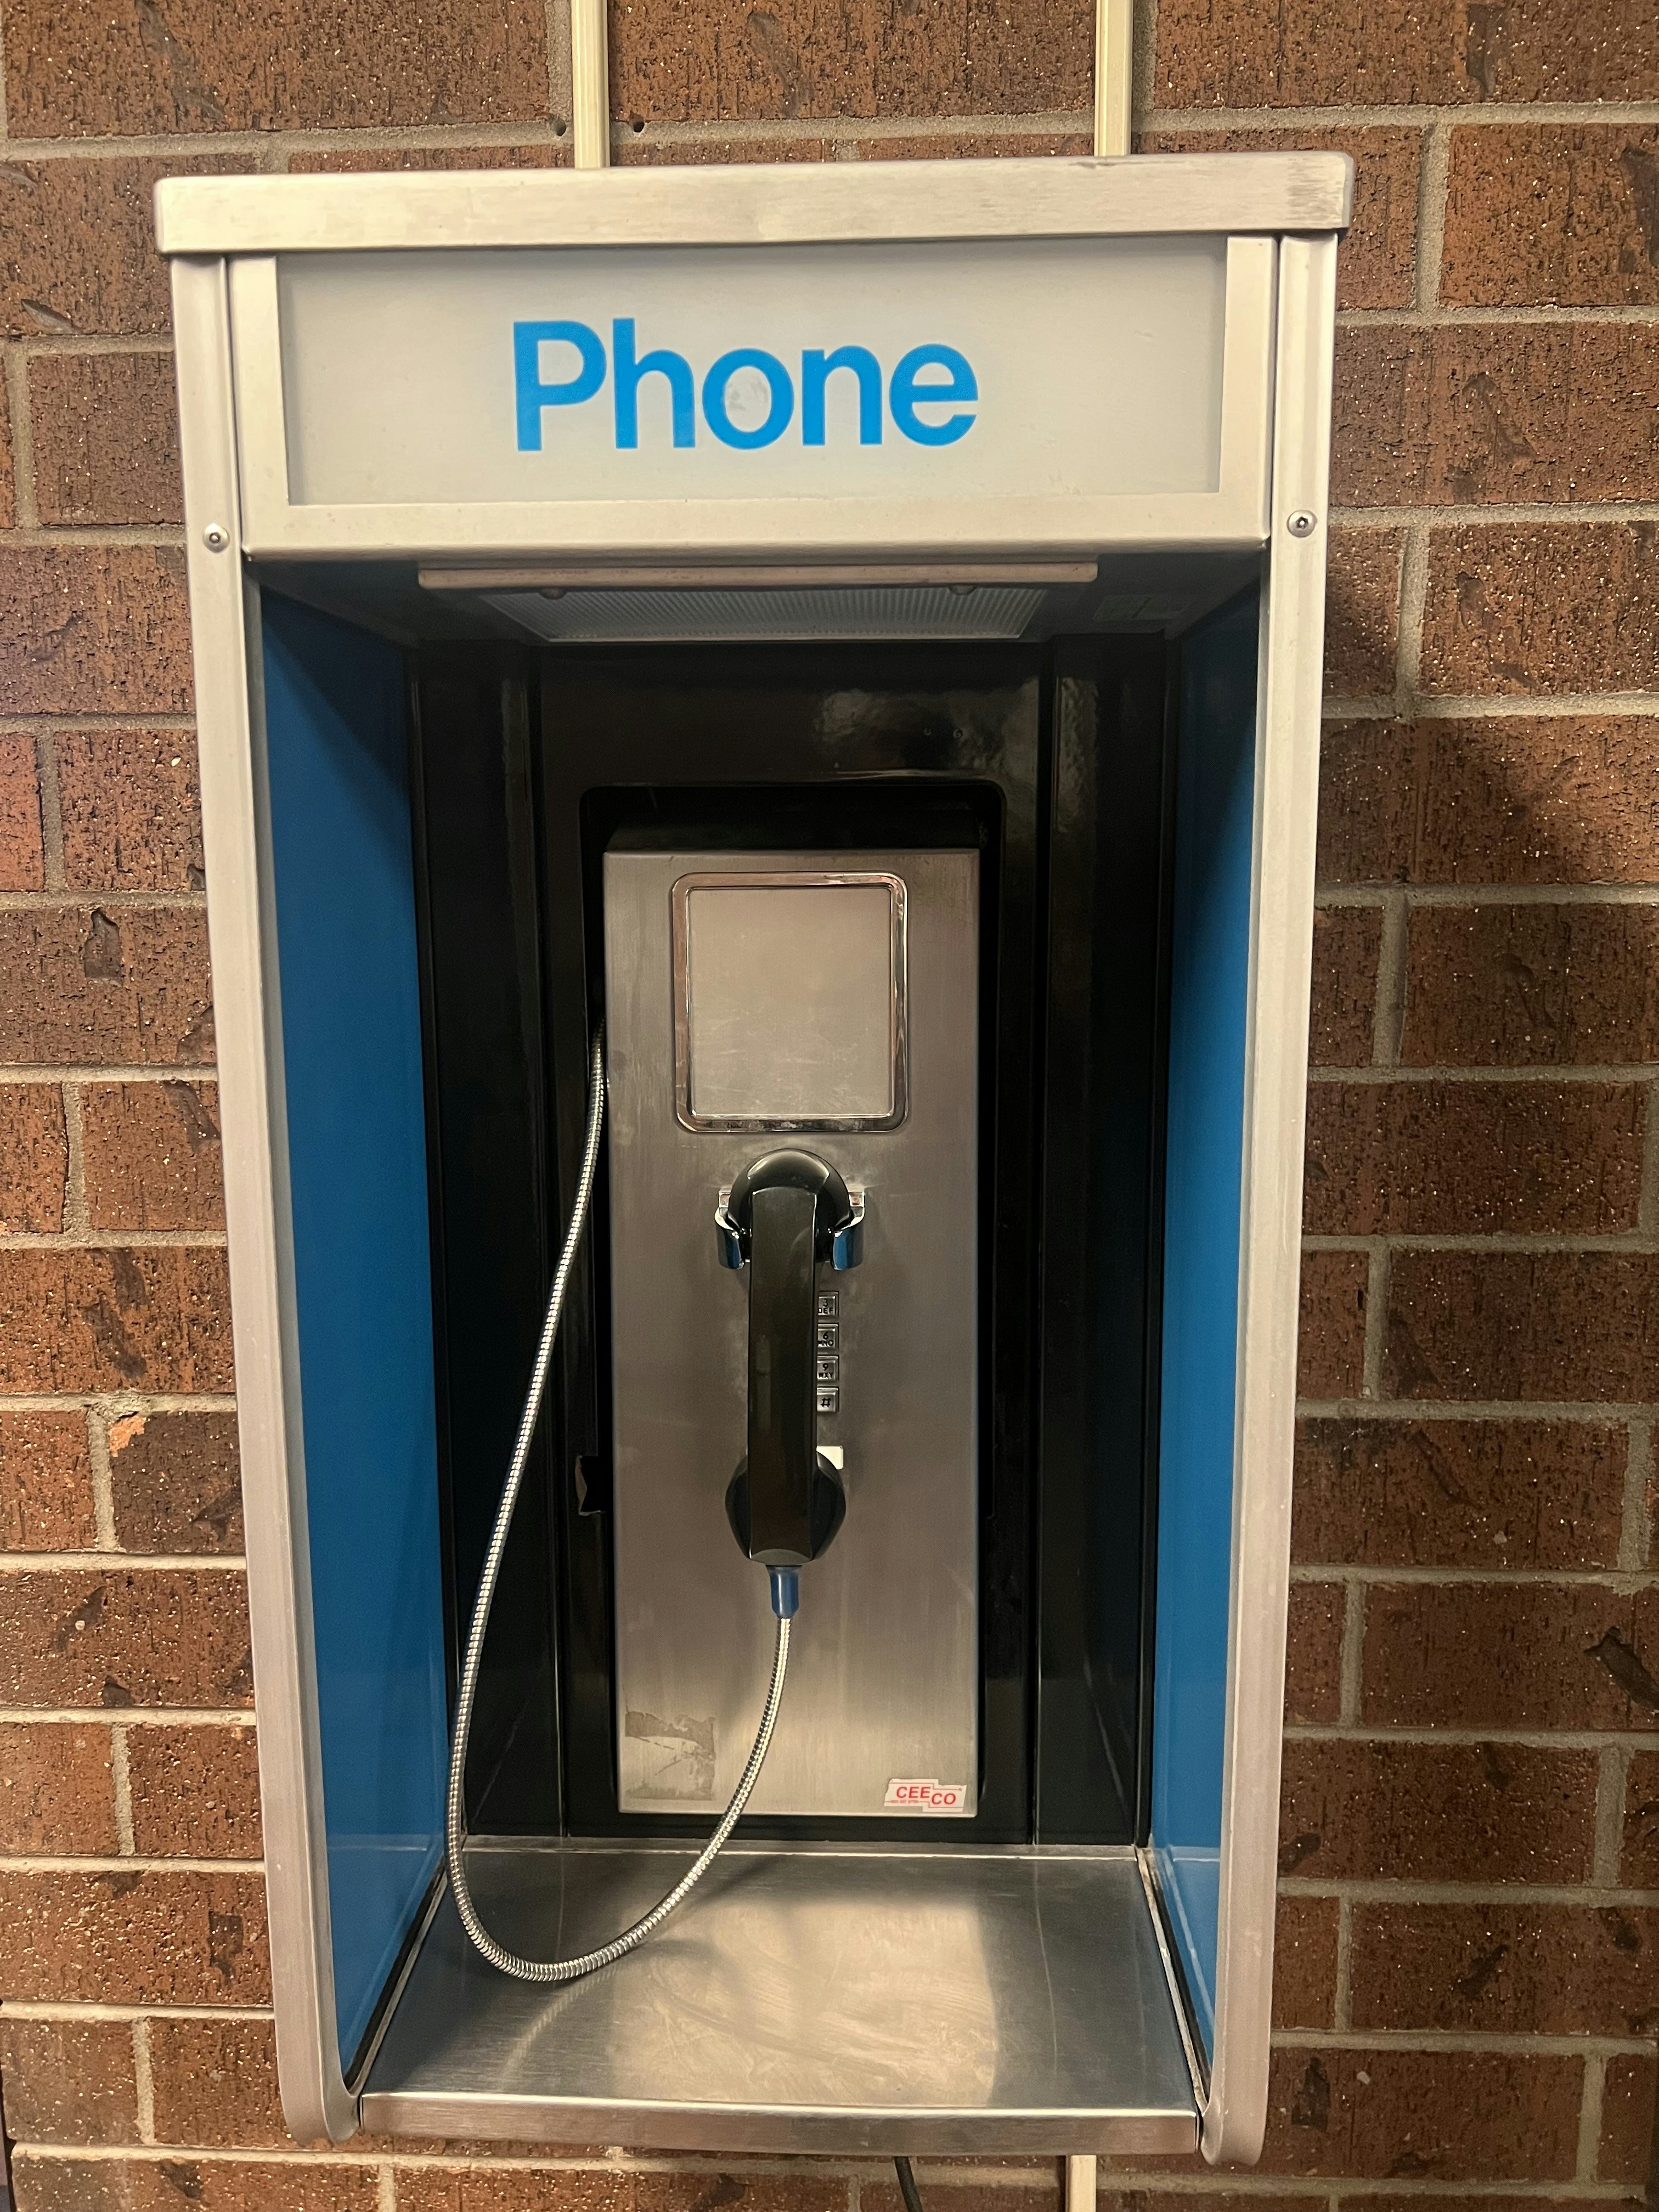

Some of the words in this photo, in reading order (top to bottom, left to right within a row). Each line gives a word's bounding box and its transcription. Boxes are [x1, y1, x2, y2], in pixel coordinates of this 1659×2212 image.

[514, 318, 978, 451] Phone
[823, 1299, 828, 1307] 3
[823, 1363, 828, 1371] 9
